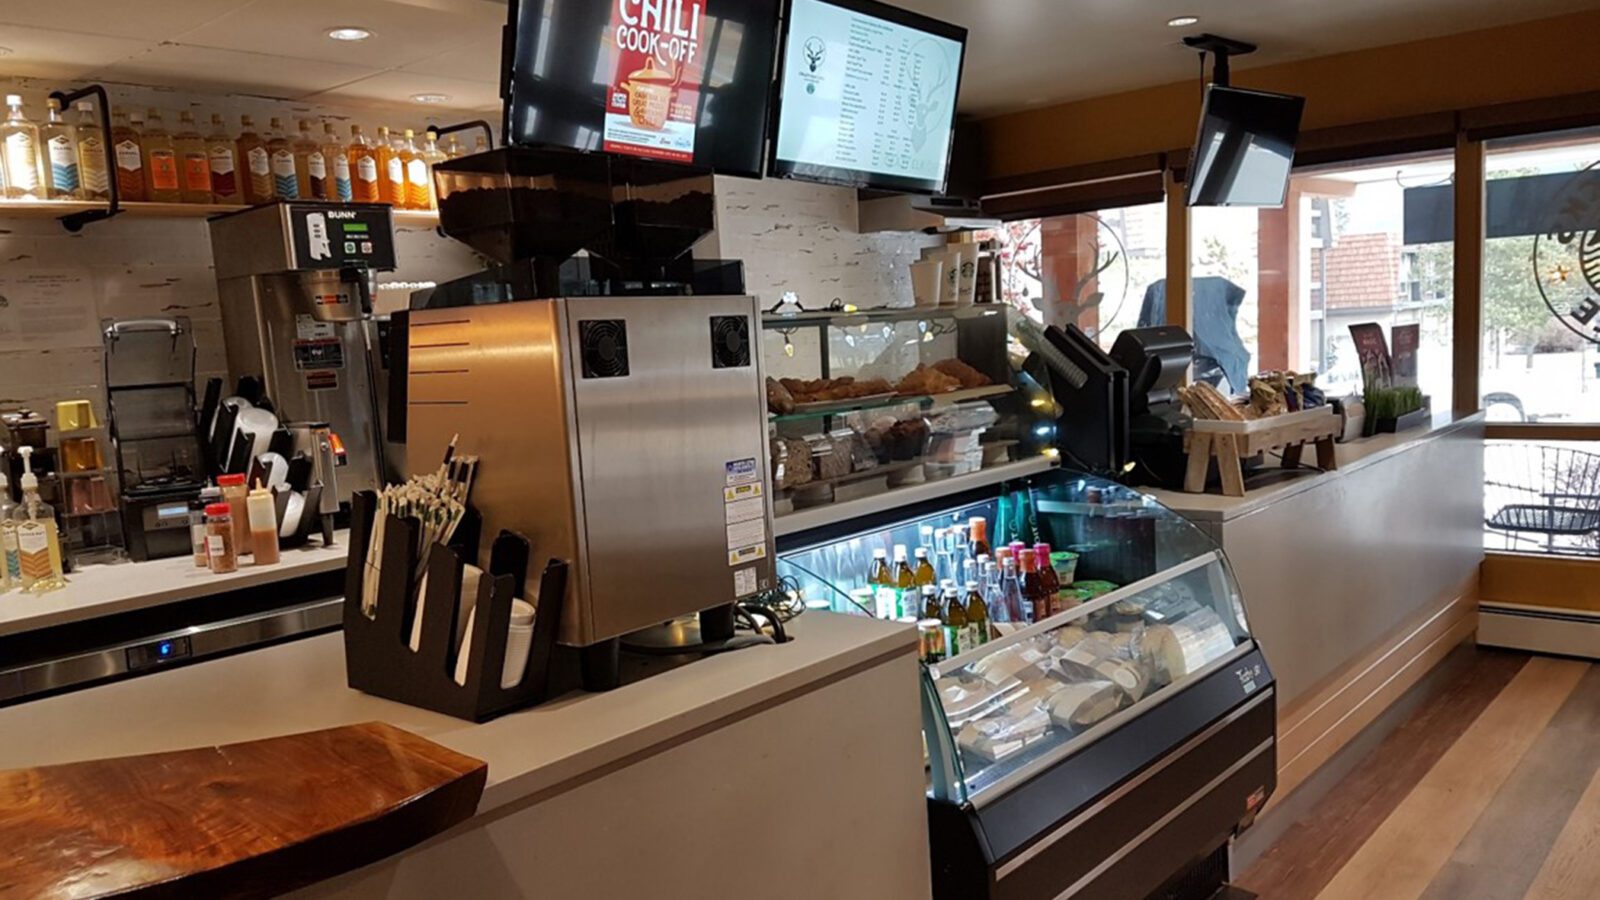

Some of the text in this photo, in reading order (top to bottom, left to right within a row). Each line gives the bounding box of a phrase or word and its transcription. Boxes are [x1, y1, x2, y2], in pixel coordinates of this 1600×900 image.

[620, 0, 700, 39] CHILI
[616, 25, 698, 66] COOK-OFF
[328, 210, 355, 219] BUNN
